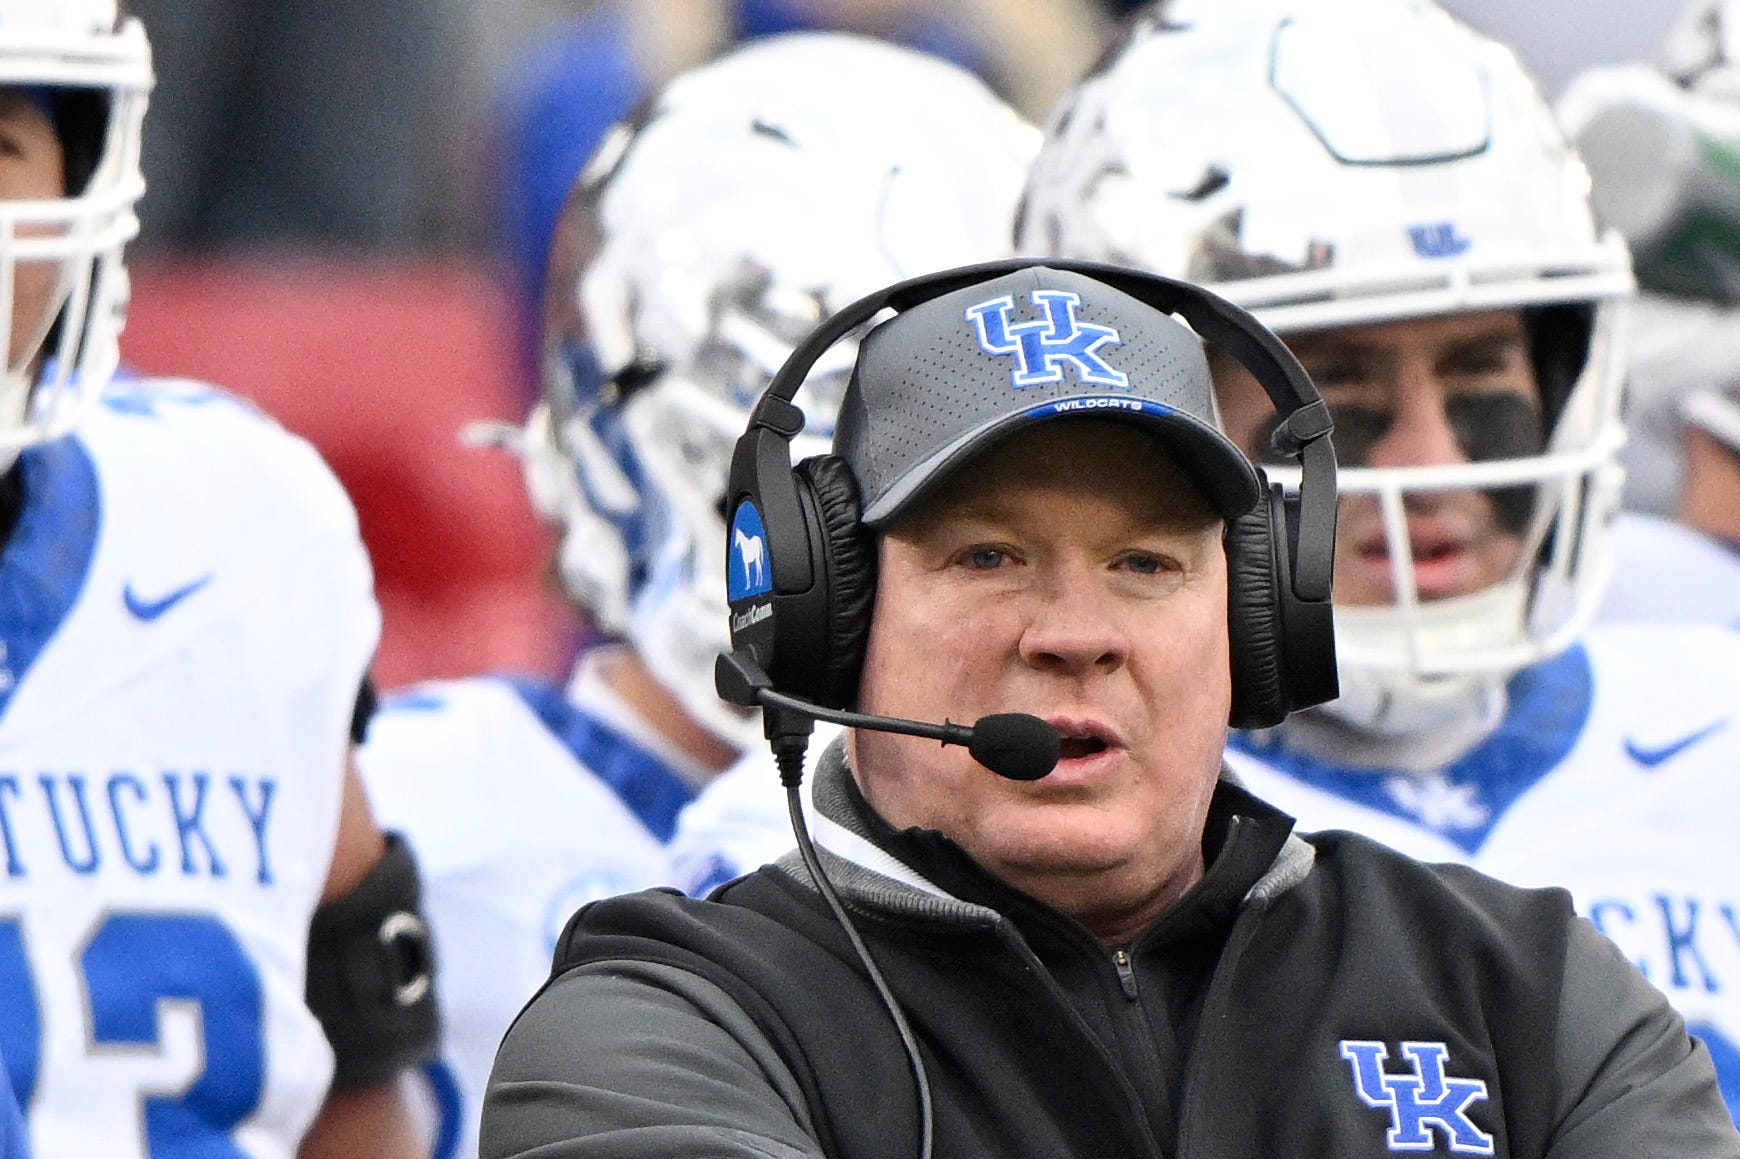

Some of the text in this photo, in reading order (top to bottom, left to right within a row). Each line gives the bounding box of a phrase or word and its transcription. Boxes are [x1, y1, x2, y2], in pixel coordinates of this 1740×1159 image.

[965, 290, 1131, 391] UK
[1053, 399, 1143, 413] WILDCATS
[1339, 1040, 1495, 1155] UK
